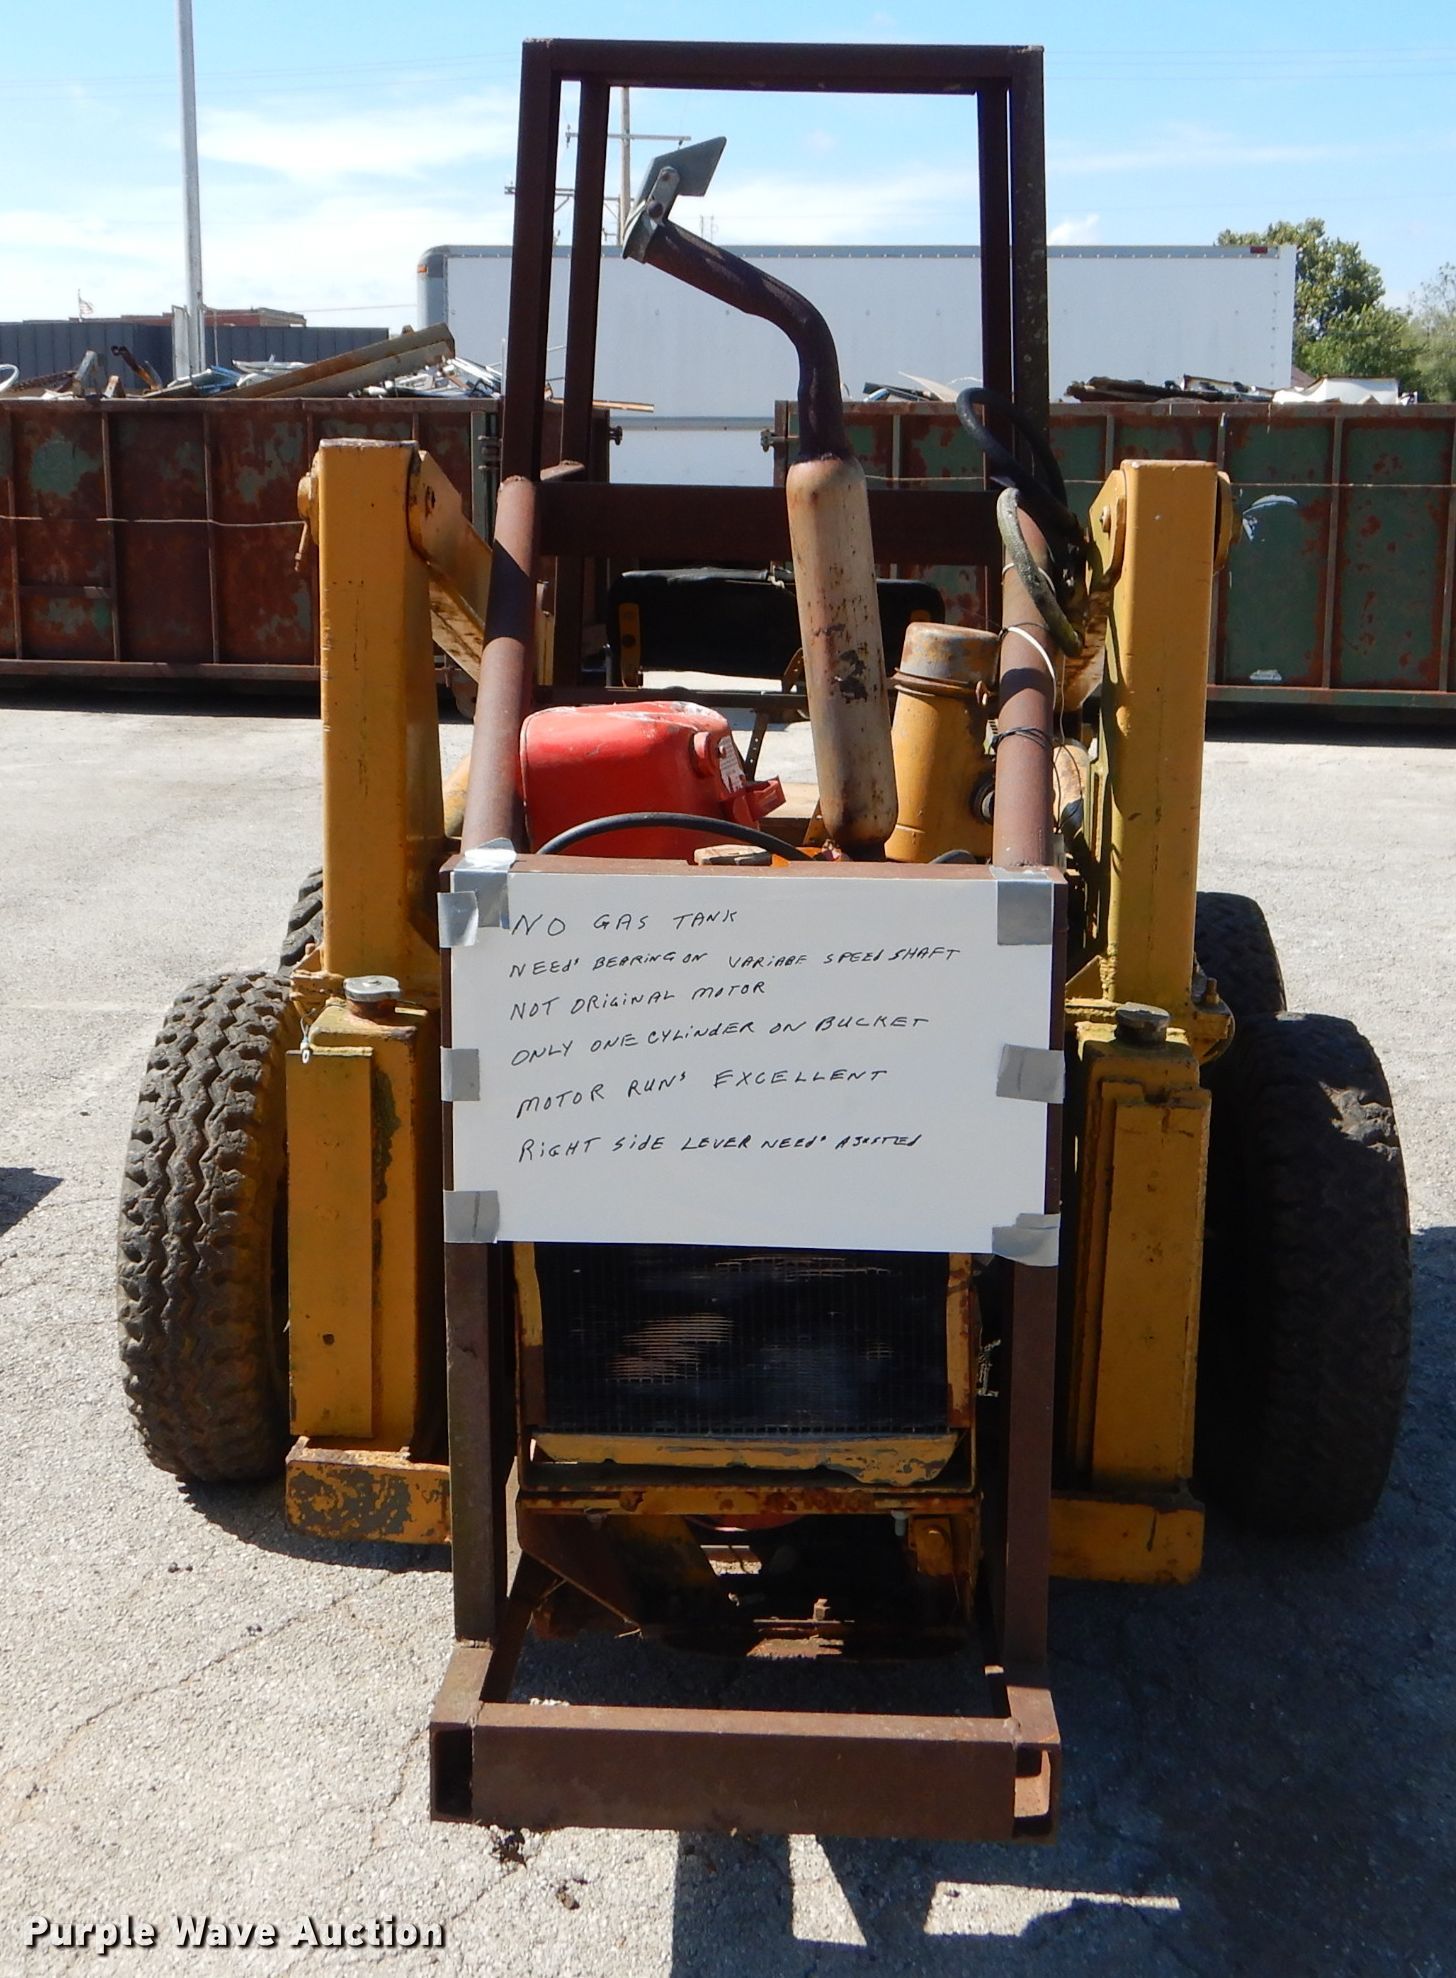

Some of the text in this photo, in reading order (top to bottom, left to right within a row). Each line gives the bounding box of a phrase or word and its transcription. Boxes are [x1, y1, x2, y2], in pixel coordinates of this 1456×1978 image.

[511, 909, 738, 937] NO GAS TANK
[888, 946, 961, 961] SHAFT
[510, 997, 560, 1020] NOT
[691, 980, 766, 1000] MOTOR
[511, 1040, 573, 1066] ONLY
[590, 1033, 639, 1052] ONE
[768, 1020, 807, 1034] ON
[814, 1014, 929, 1032] BUCKET
[516, 1083, 605, 1118] MOTOR
[713, 1068, 888, 1089] EXCELLENT
[680, 1133, 752, 1151] LEVER
